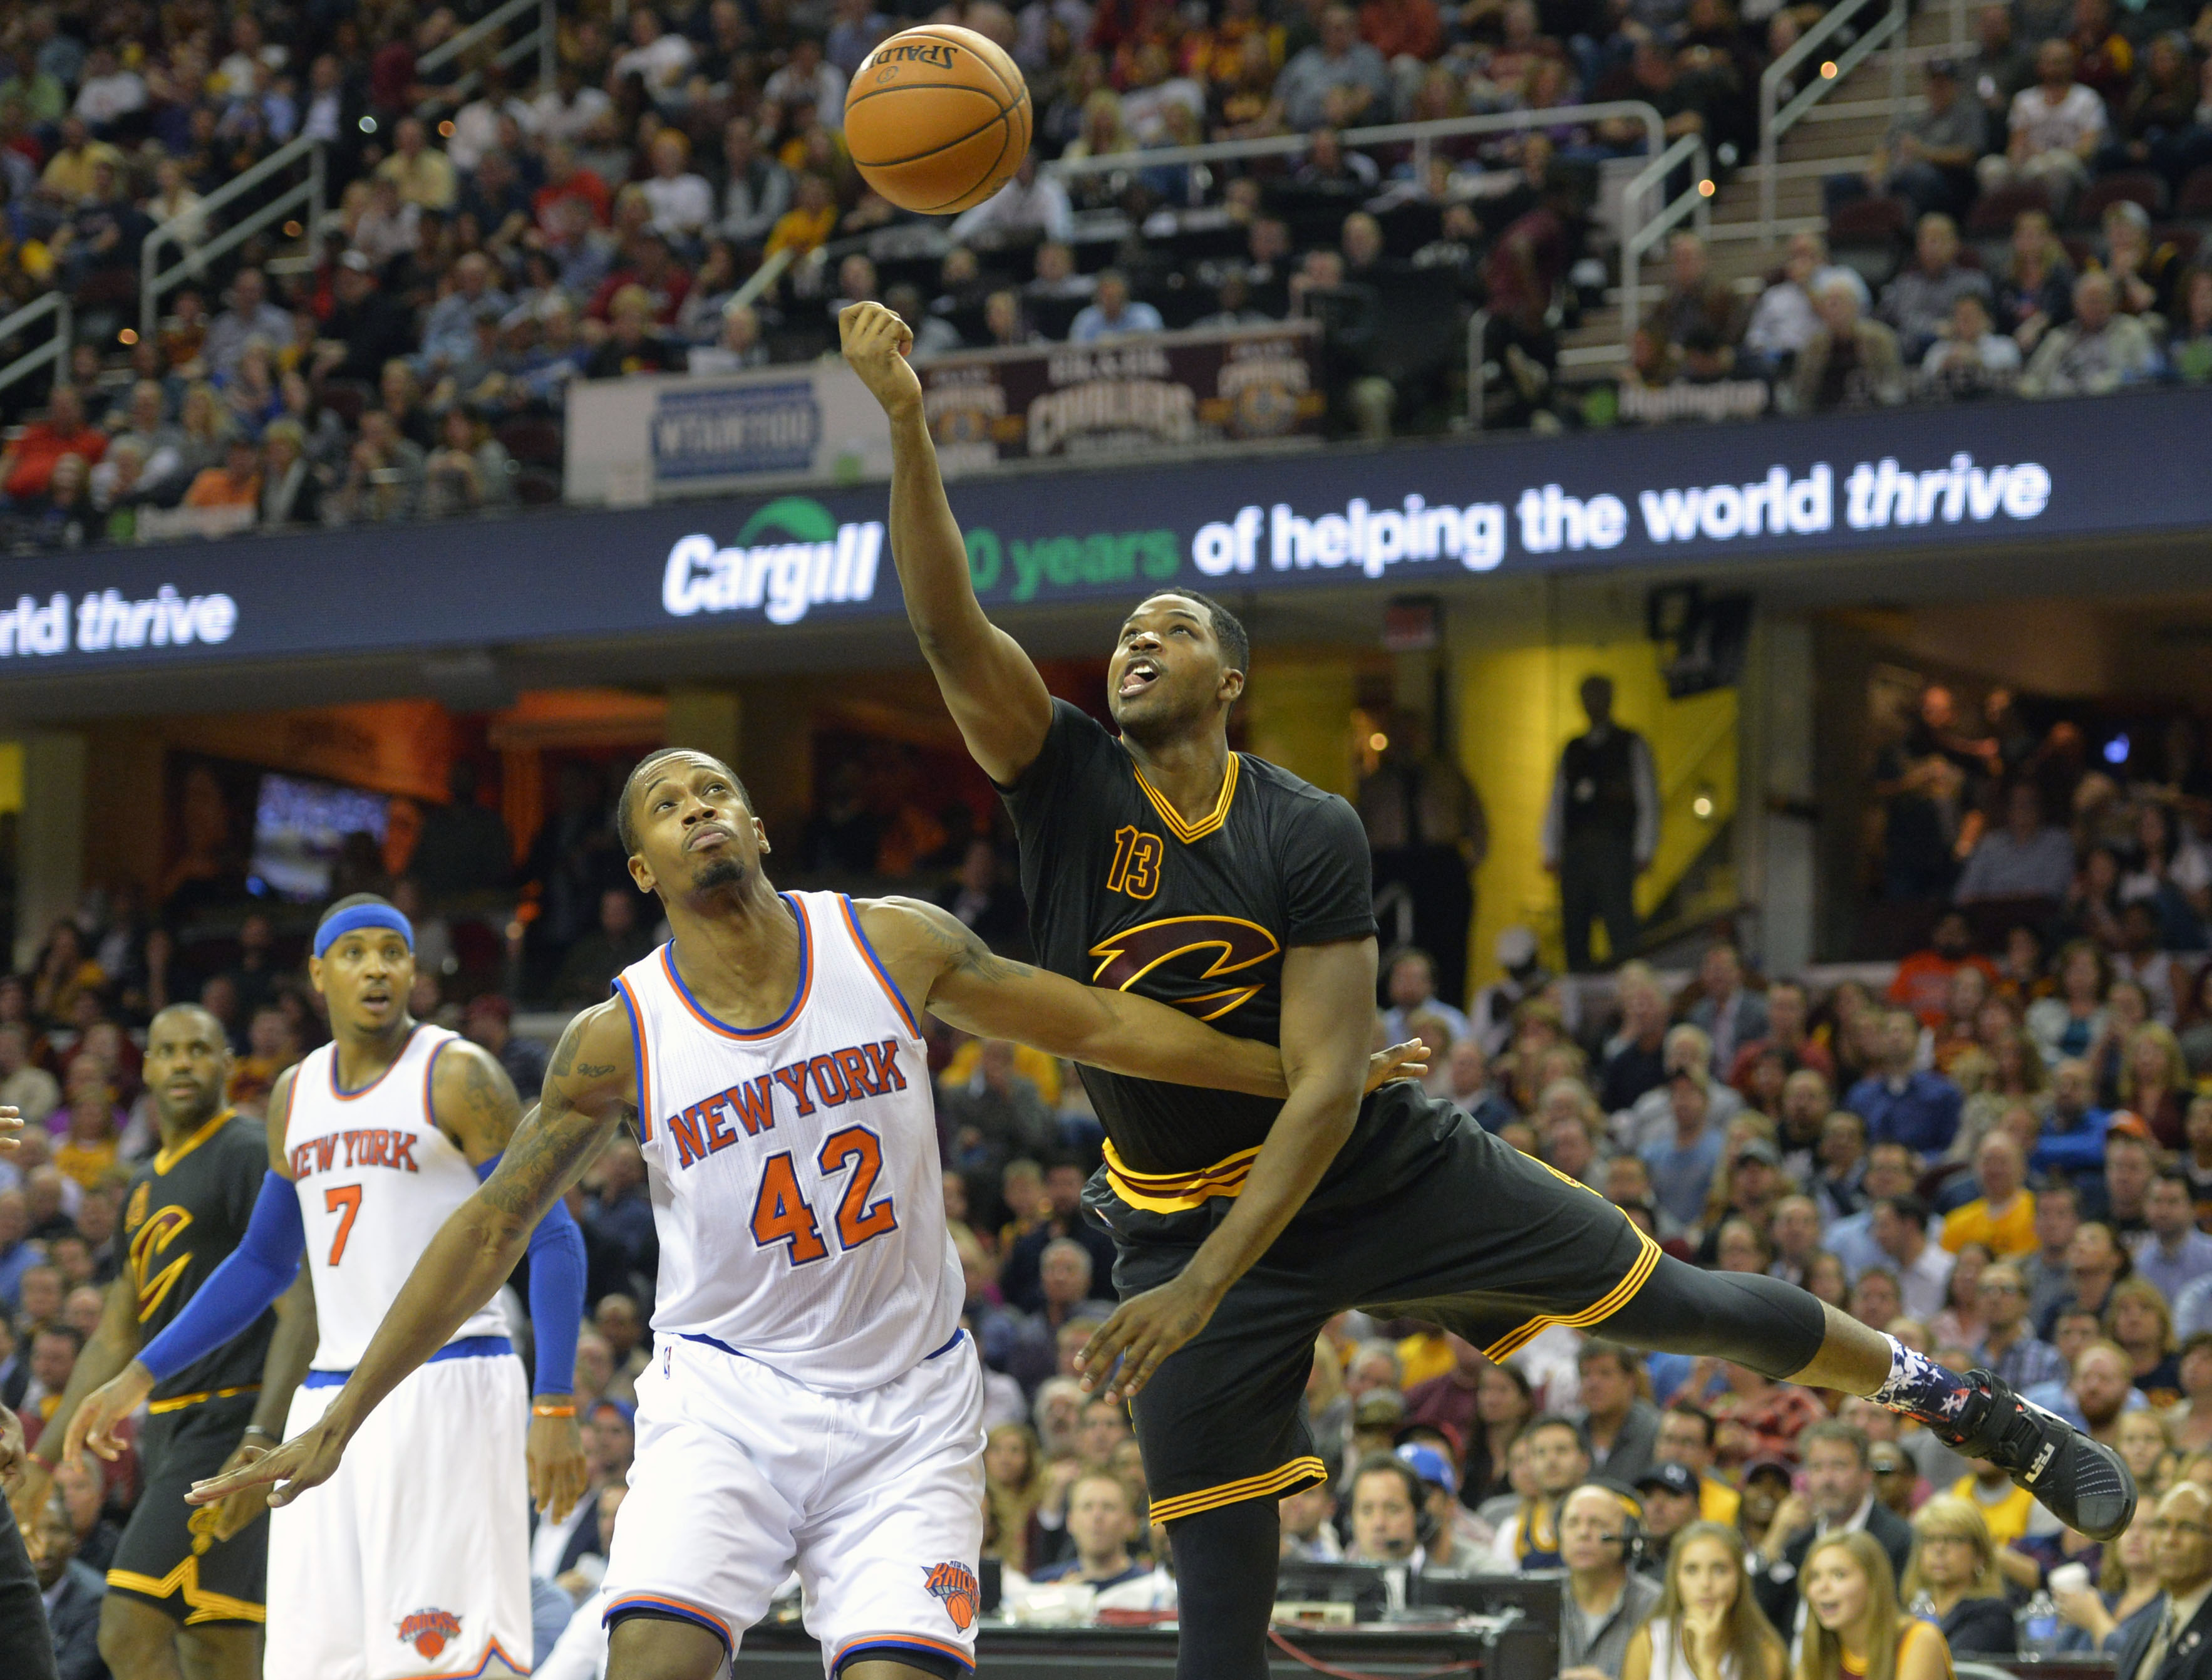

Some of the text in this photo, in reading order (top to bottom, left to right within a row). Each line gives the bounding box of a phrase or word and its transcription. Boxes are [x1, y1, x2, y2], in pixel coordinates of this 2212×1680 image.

[867, 46, 958, 70] SPALDI
[1008, 529, 1181, 601] years
[1192, 506, 1264, 576] of
[1271, 494, 1506, 578] helping
[1516, 484, 1628, 554] the
[1639, 462, 1834, 543] world
[1844, 451, 2051, 531] thrive
[663, 522, 885, 625] Cargill
[76, 583, 238, 651] thrive
[1107, 825, 1163, 900] 13
[666, 1040, 907, 1171] NEW YORK
[342, 1129, 418, 1173] YORK
[325, 1184, 361, 1266] 7
[749, 1121, 899, 1269] 42
